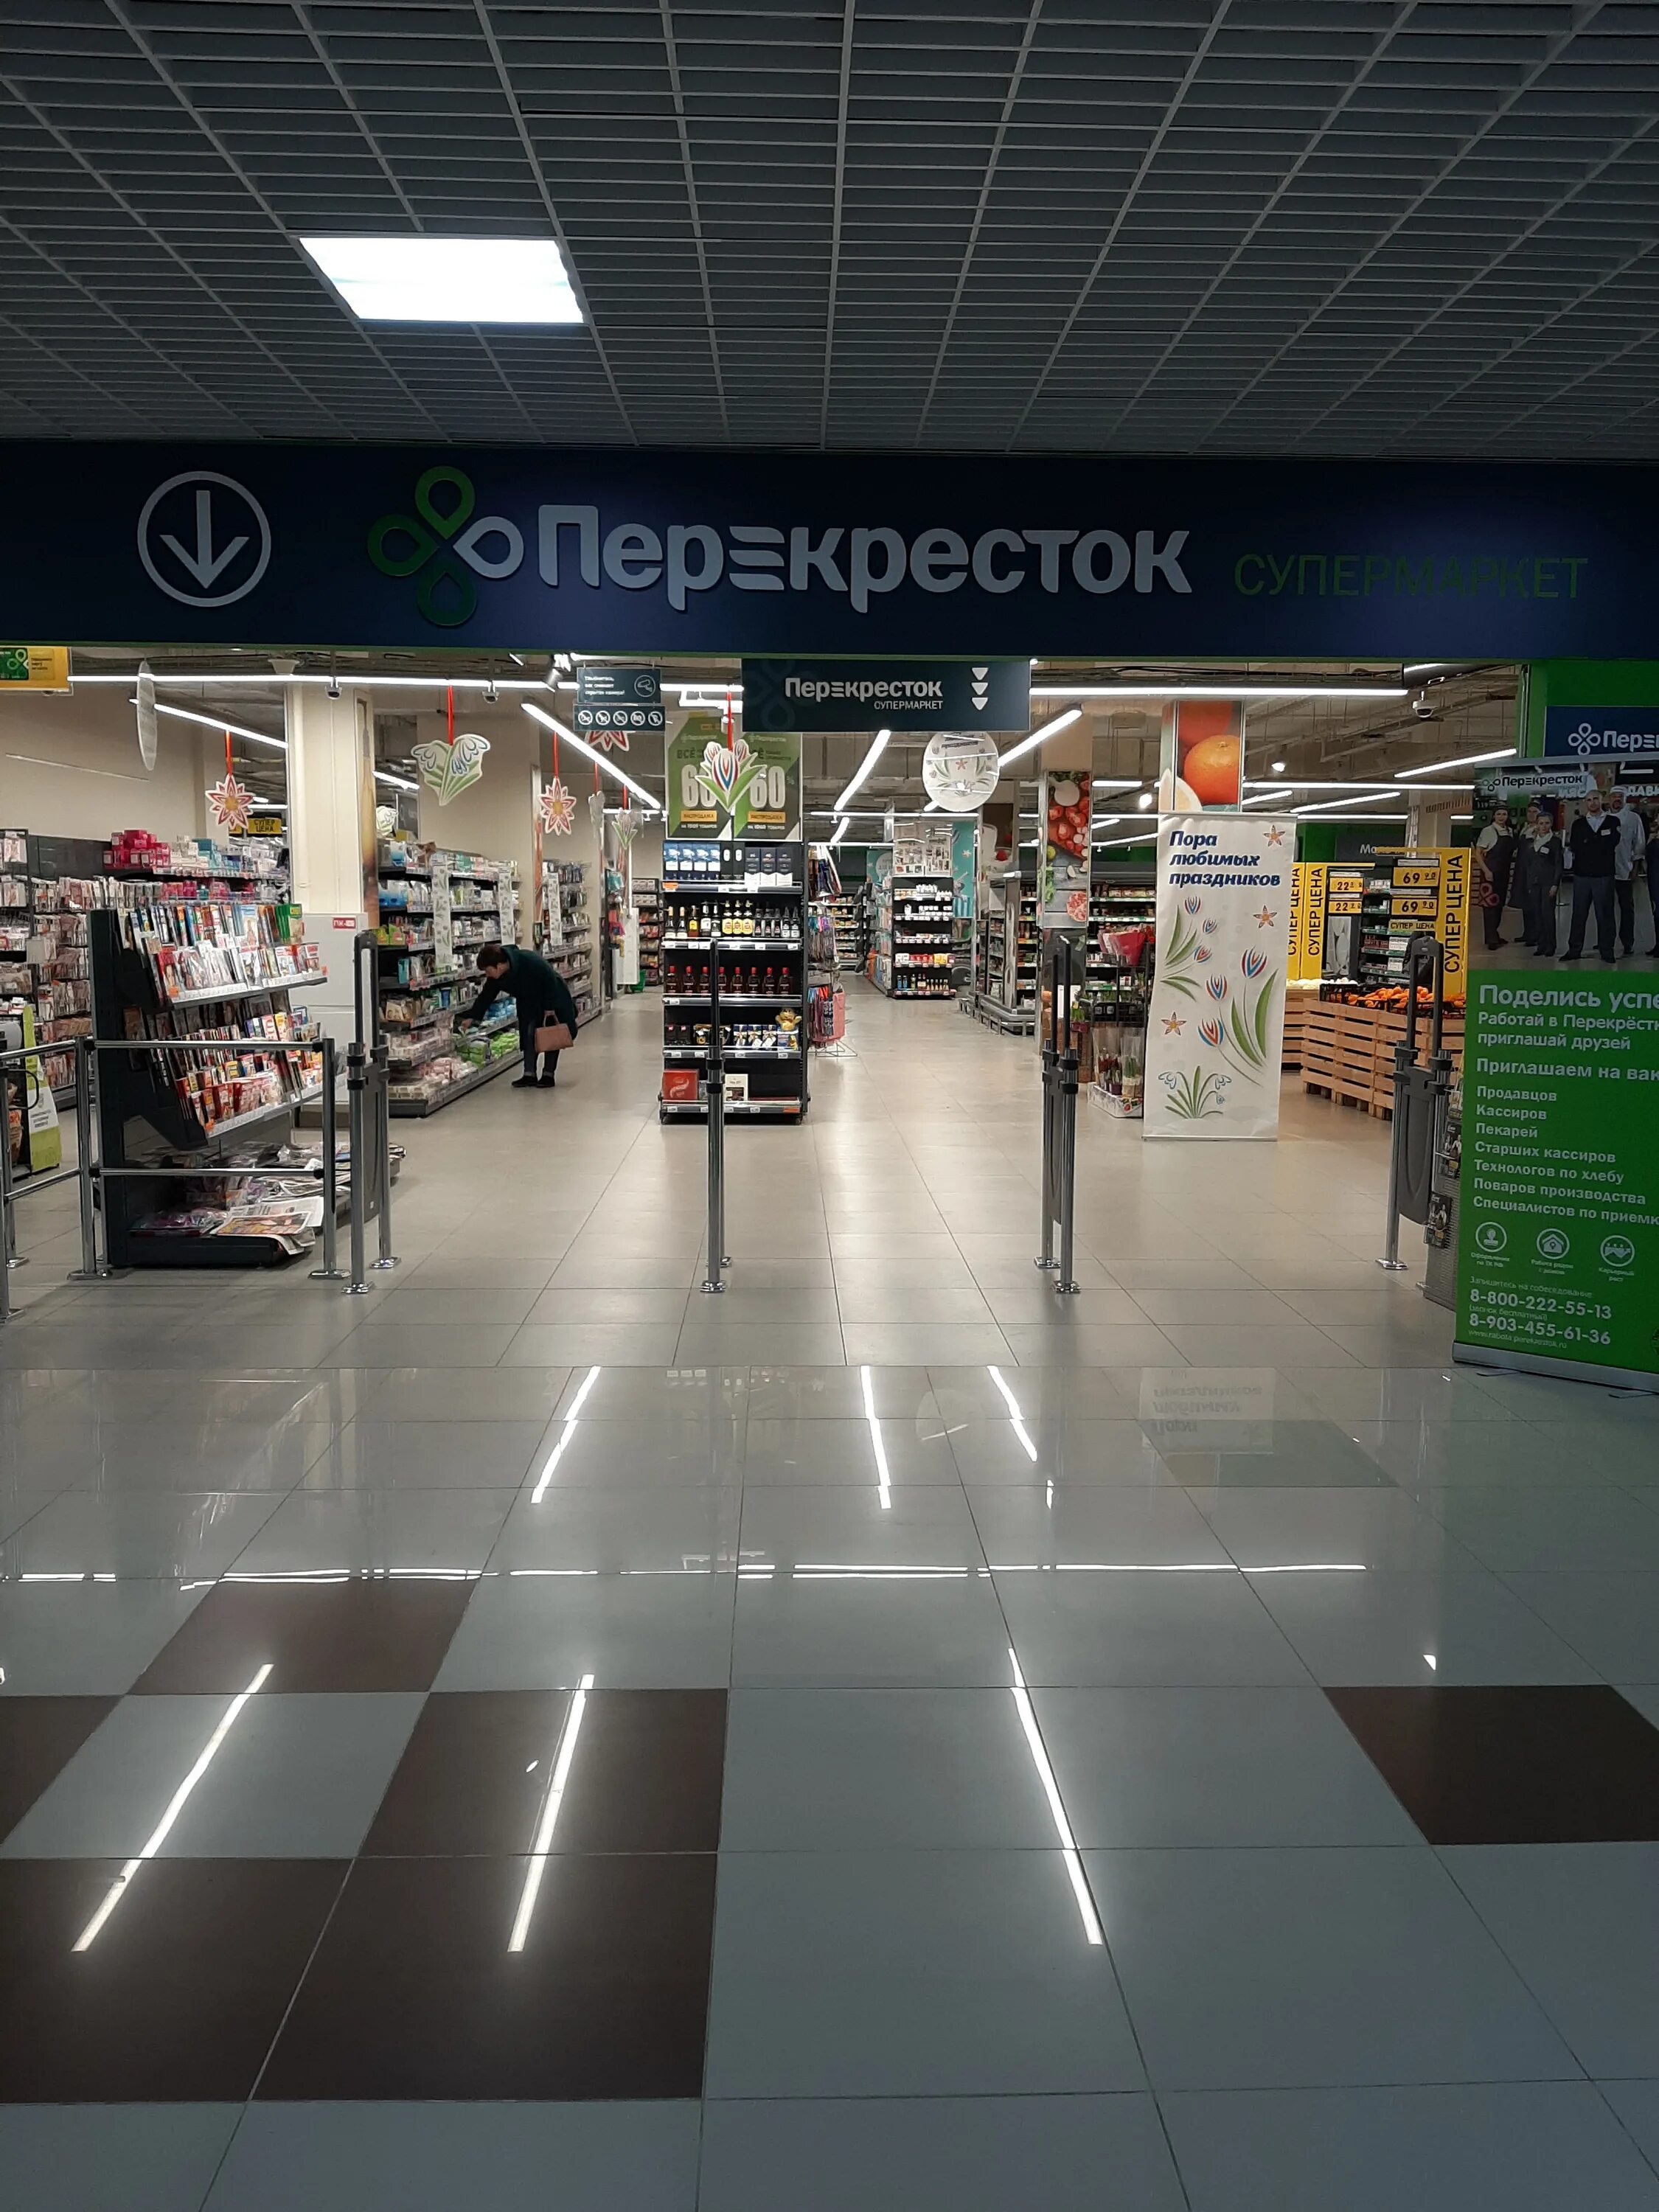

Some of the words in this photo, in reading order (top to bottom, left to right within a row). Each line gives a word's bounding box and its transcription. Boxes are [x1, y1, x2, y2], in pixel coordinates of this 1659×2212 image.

[538, 504, 1192, 613] Перекресток
[1234, 553, 1589, 598] СУПЕРМАРКЕТ
[785, 678, 943, 701] Перекресток
[874, 700, 943, 710] СУПЕРМАРКЕТ
[1603, 731, 1659, 752] Пере
[1502, 775, 1583, 788] Перекресток
[1169, 830, 1217, 849] Пора
[1169, 850, 1260, 866] любимых
[1169, 873, 1281, 888] праздников
[1310, 868, 1324, 908] ЦЕНА
[1337, 881, 1349, 891] 22
[1403, 872, 1420, 884] 69
[1446, 855, 1464, 908] ЦЕНА
[1335, 902, 1348, 911] 22
[1402, 901, 1419, 912] 69
[1308, 911, 1321, 956] СУПЕР
[1444, 912, 1461, 973] СУПЕР
[1480, 985, 1601, 1009] Поделись
[1478, 1012, 1544, 1027] Работай
[1549, 1018, 1558, 1027] в
[1478, 1033, 1567, 1047] приглашай
[1571, 1037, 1631, 1051] друзей
[1477, 1058, 1592, 1077] Приглашаем
[1599, 1068, 1620, 1079] на
[1477, 1085, 1557, 1102] Продавцов
[1476, 1105, 1547, 1120] Кассиров
[1476, 1123, 1538, 1138] Пекарей
[1475, 1141, 1540, 1157] Старших
[1544, 1147, 1616, 1164] кассиров
[1474, 1159, 1555, 1178] Технологов
[1559, 1168, 1577, 1178] по
[1582, 1170, 1624, 1185] хлебу
[1474, 1178, 1536, 1194] Поваров
[1540, 1186, 1646, 1205] производства
[1474, 1196, 1575, 1217] Специалистов
[1580, 1209, 1597, 1219] по
[1470, 1288, 1613, 1319] 8-800-222-55-13
[1470, 1312, 1611, 1345] 8-903-455-61-36
